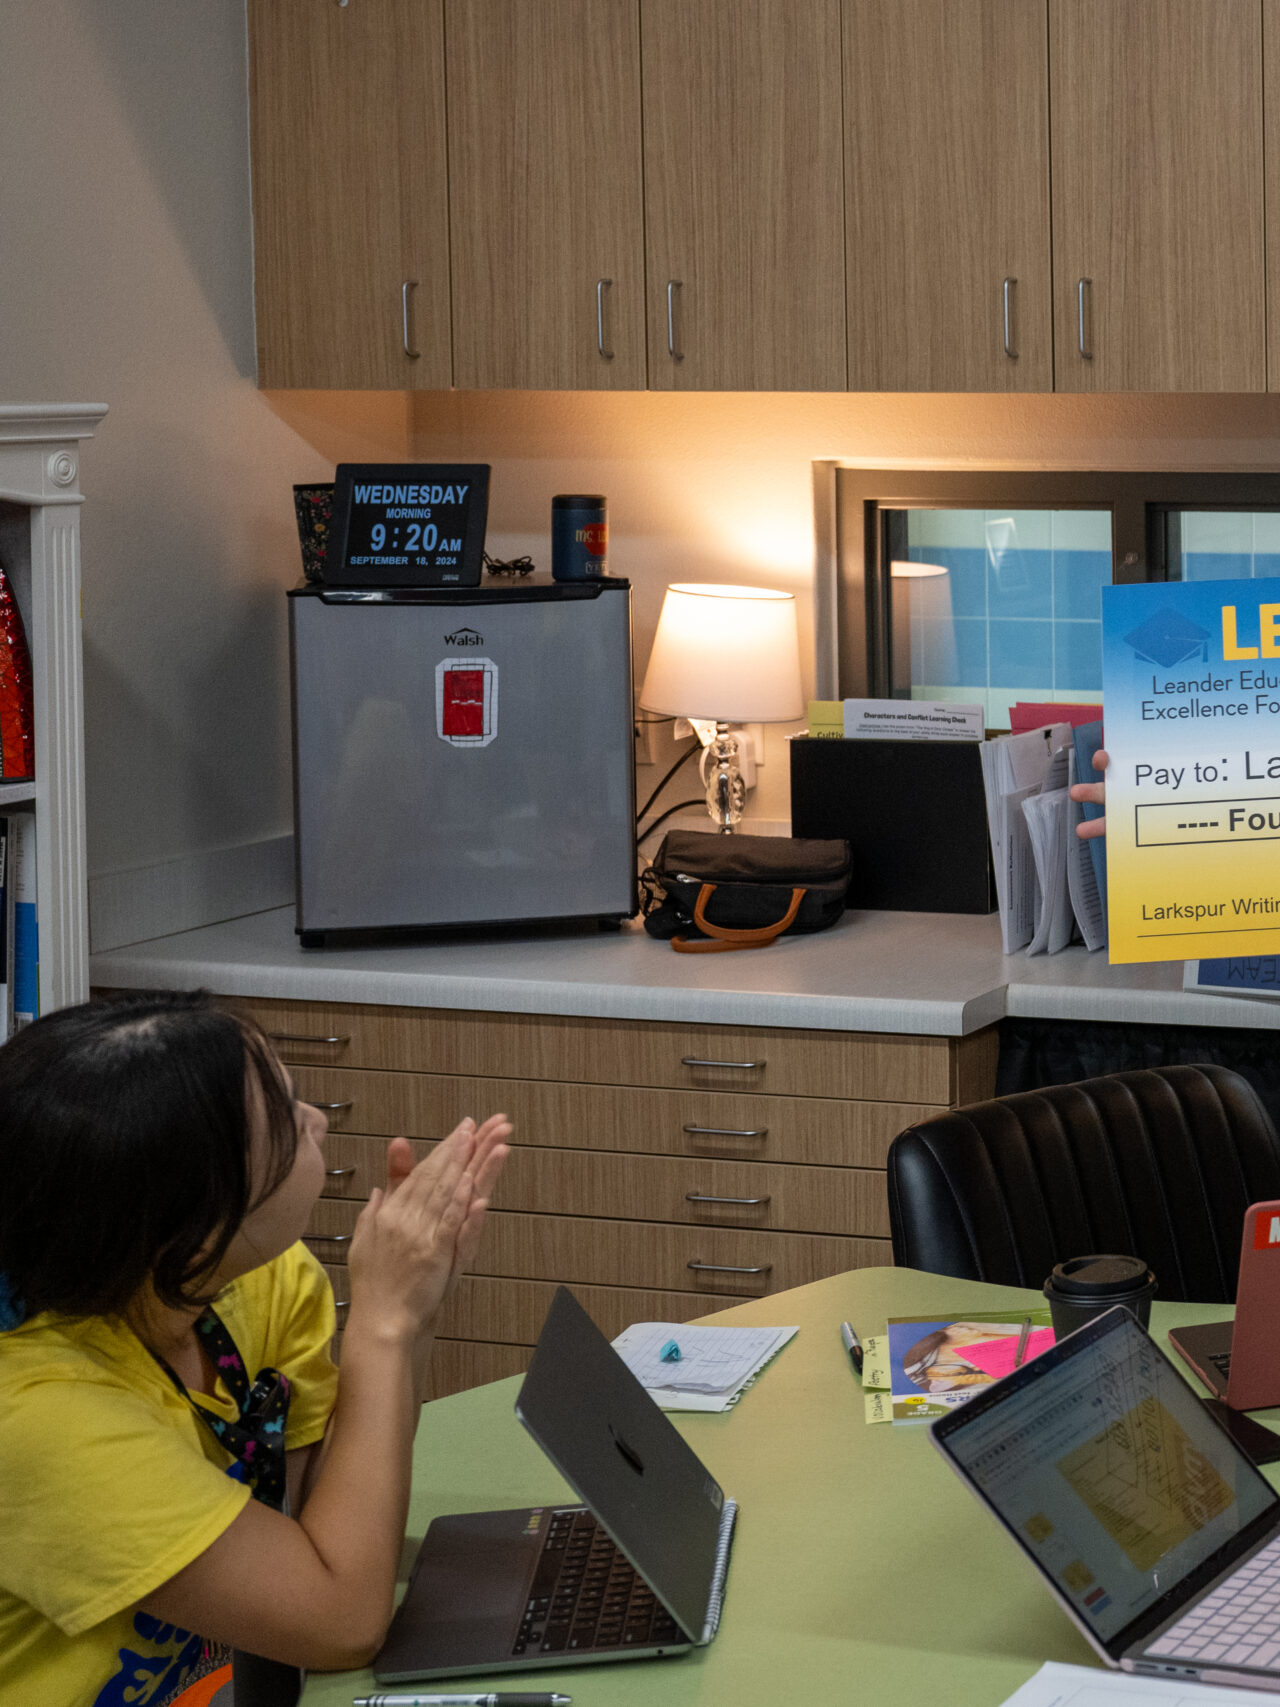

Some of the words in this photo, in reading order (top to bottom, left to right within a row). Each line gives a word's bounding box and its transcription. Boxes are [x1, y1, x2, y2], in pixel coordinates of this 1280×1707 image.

[354, 485, 469, 505] WEDNESDAY
[385, 508, 431, 519] MORNING
[370, 523, 438, 551] 9:20
[438, 539, 462, 552] AM
[350, 556, 409, 565] SEPTEMBER
[415, 556, 429, 567] 18,
[435, 556, 457, 565] 2024
[444, 634, 485, 647] Walsh
[1152, 672, 1234, 694] Leander
[864, 712, 896, 721] Characters
[907, 713, 929, 722] Conflict
[929, 715, 952, 724] Learning
[951, 716, 966, 724] Check
[1141, 698, 1249, 720] Excellence
[1135, 764, 1185, 790] Pay
[1194, 758, 1229, 783] to:
[1141, 900, 1227, 922] Larkspur
